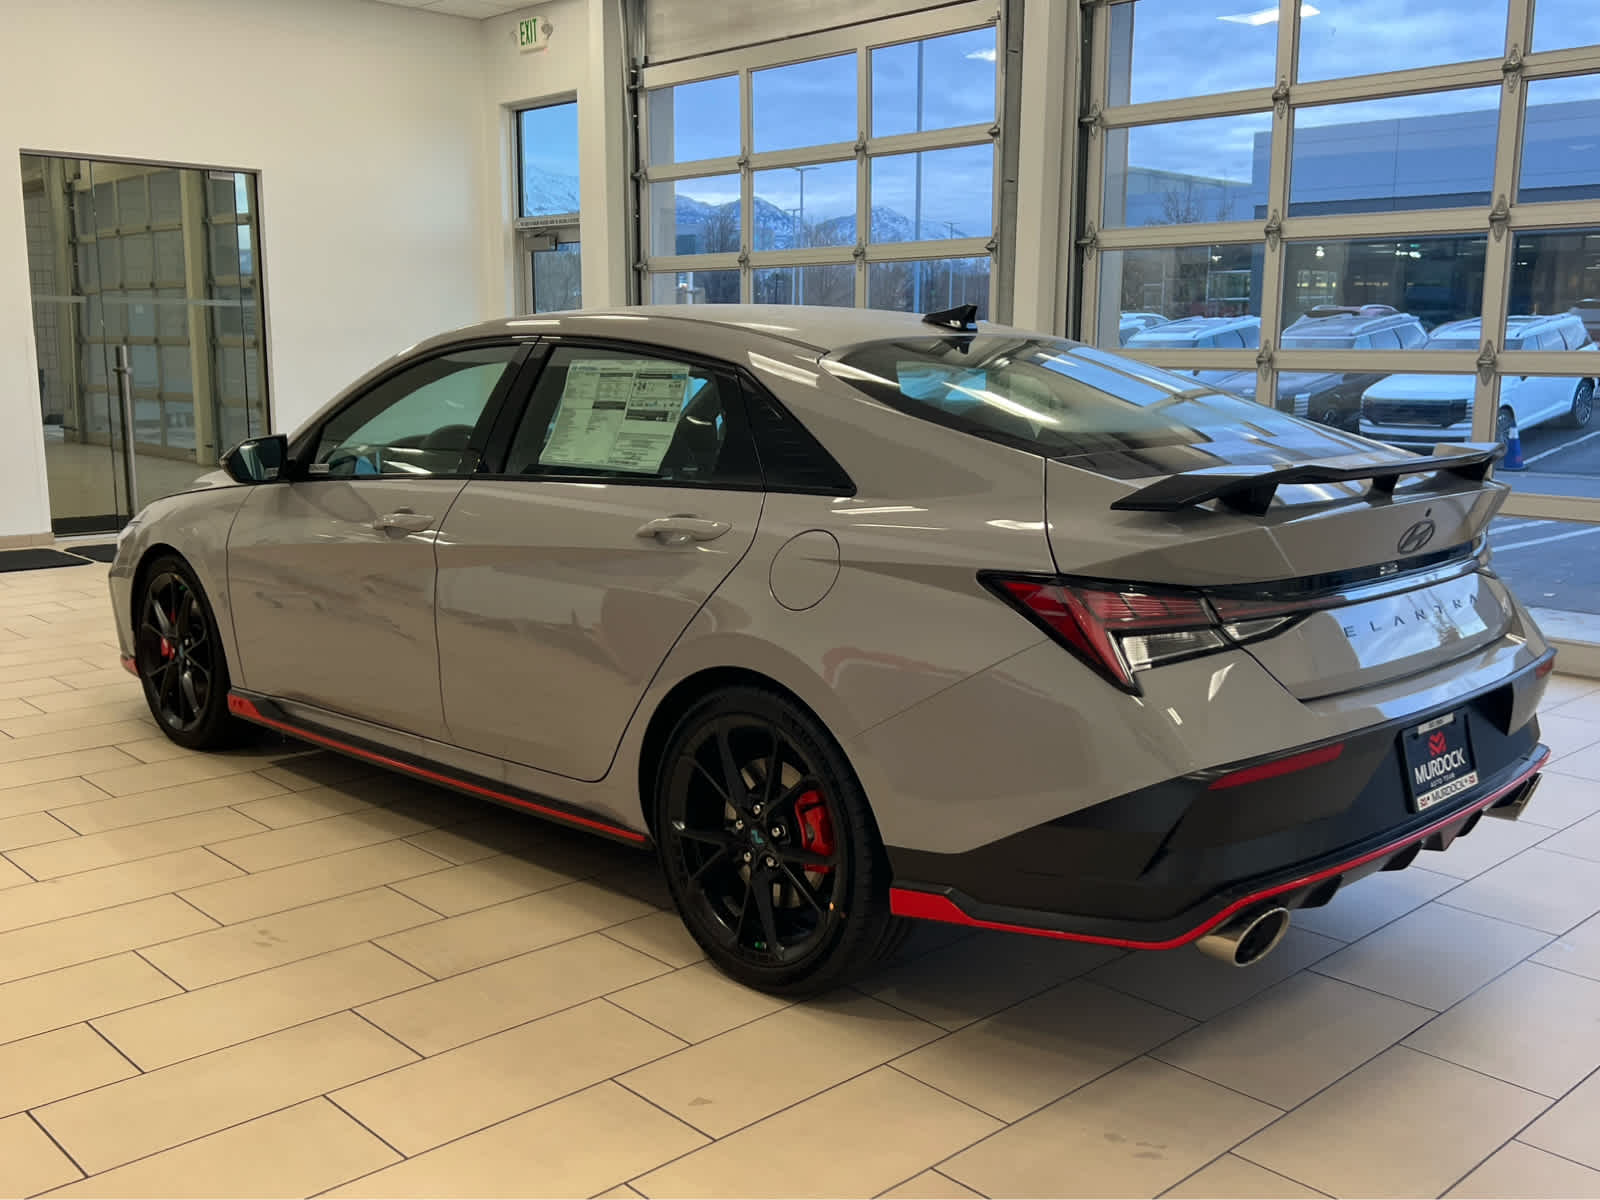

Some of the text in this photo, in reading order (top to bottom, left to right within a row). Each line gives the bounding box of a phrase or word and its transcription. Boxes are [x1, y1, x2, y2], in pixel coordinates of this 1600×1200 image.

[520, 18, 537, 46] EXIT
[1343, 593, 1478, 638] ELANTRA
[1414, 747, 1466, 784] MURDOCK
[1431, 779, 1466, 801] MURDOCK
